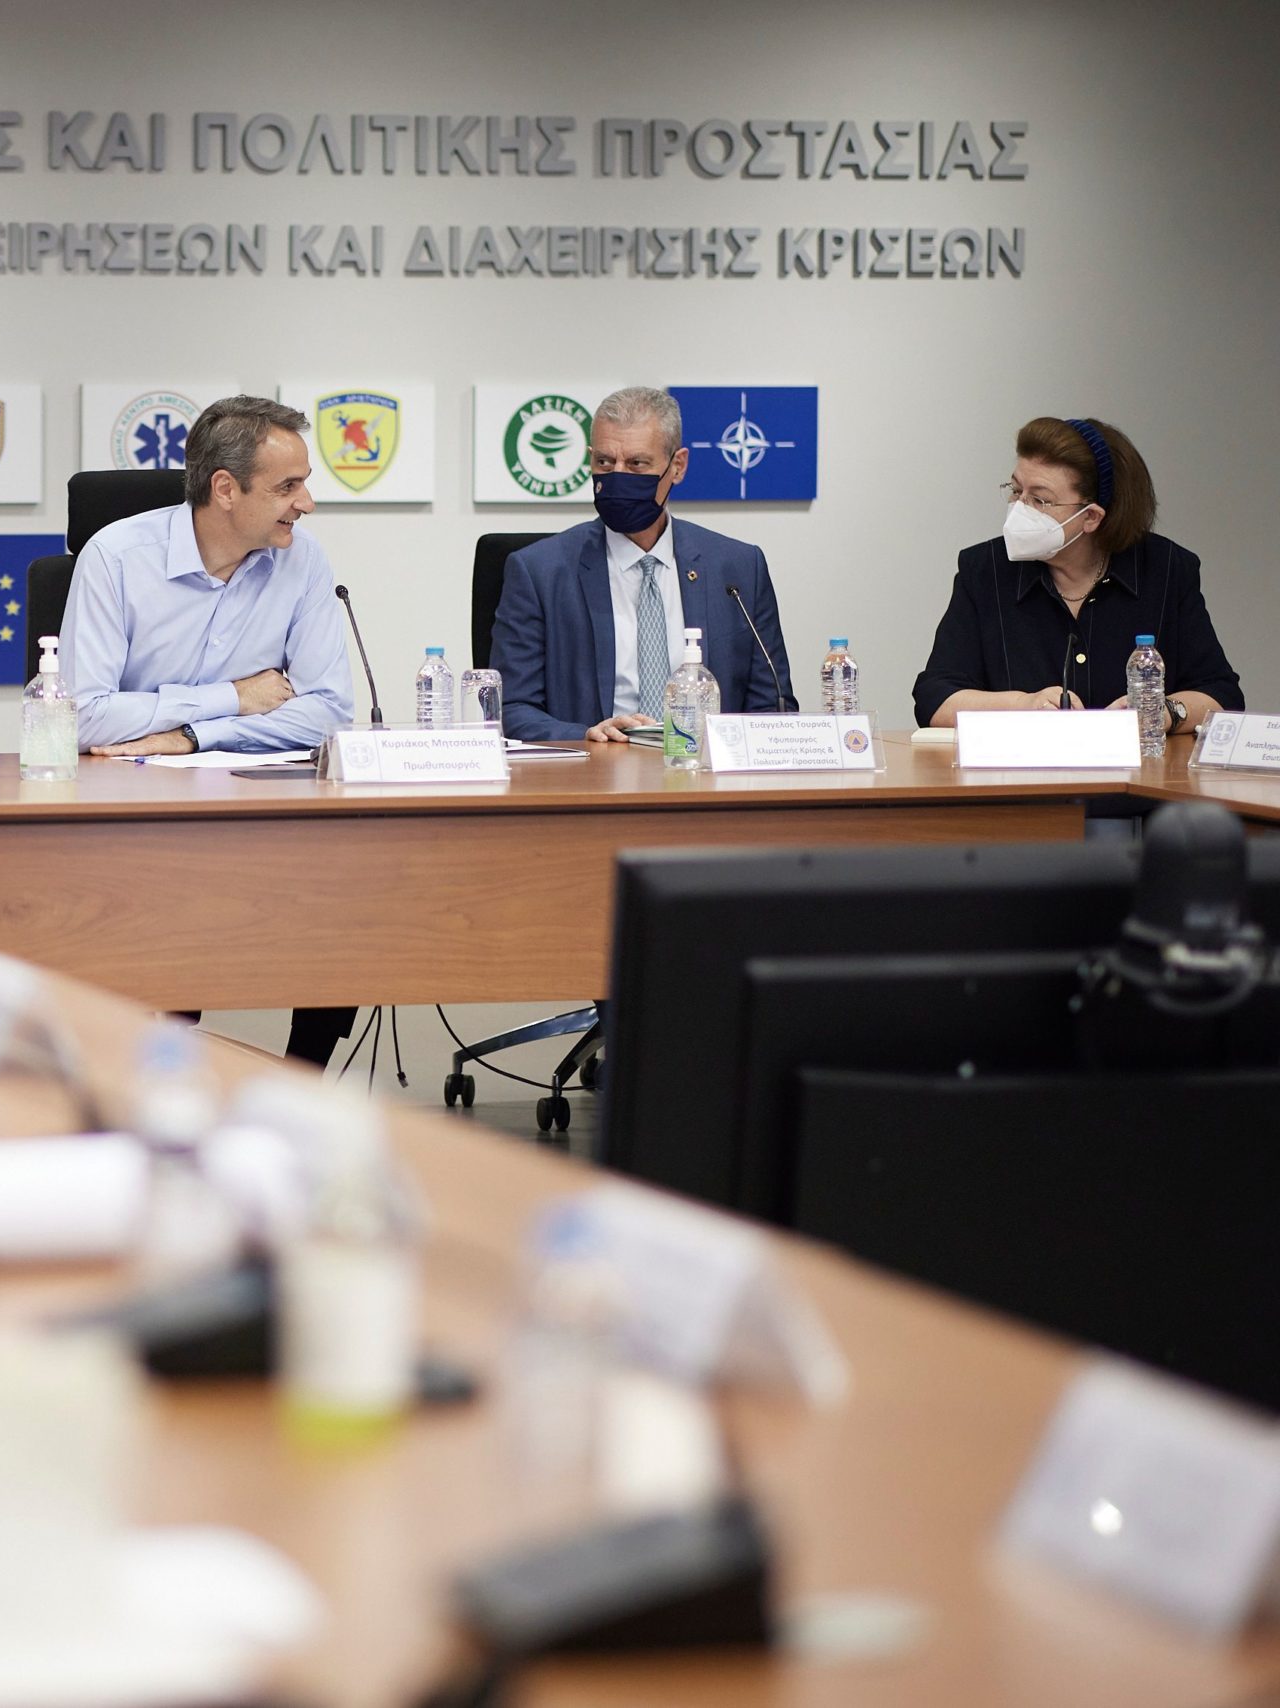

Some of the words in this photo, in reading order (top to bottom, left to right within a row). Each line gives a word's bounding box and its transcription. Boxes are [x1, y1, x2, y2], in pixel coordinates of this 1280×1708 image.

[47, 110, 167, 172] ΚΑΙ
[192, 112, 577, 177] ΠΟΛΙΤΙΚΗΣ
[596, 117, 1030, 180] ΠΡΟΣΤΑΣΙΑΣ
[288, 224, 385, 277] ΚΑΙ
[403, 225, 762, 279] ΔΙΑΧΕΙΡΙΣΗΣ
[777, 227, 1027, 279] ΚΡΙΣΕΩΝ
[750, 720, 794, 730] Ευάγγελος
[797, 719, 832, 729] Τουρνάς
[381, 736, 430, 750] Κυριάκος
[432, 736, 497, 749] Μητσοτάκης
[767, 735, 818, 745] Υφυπουργός
[403, 760, 481, 772] Πρωθυπουργός
